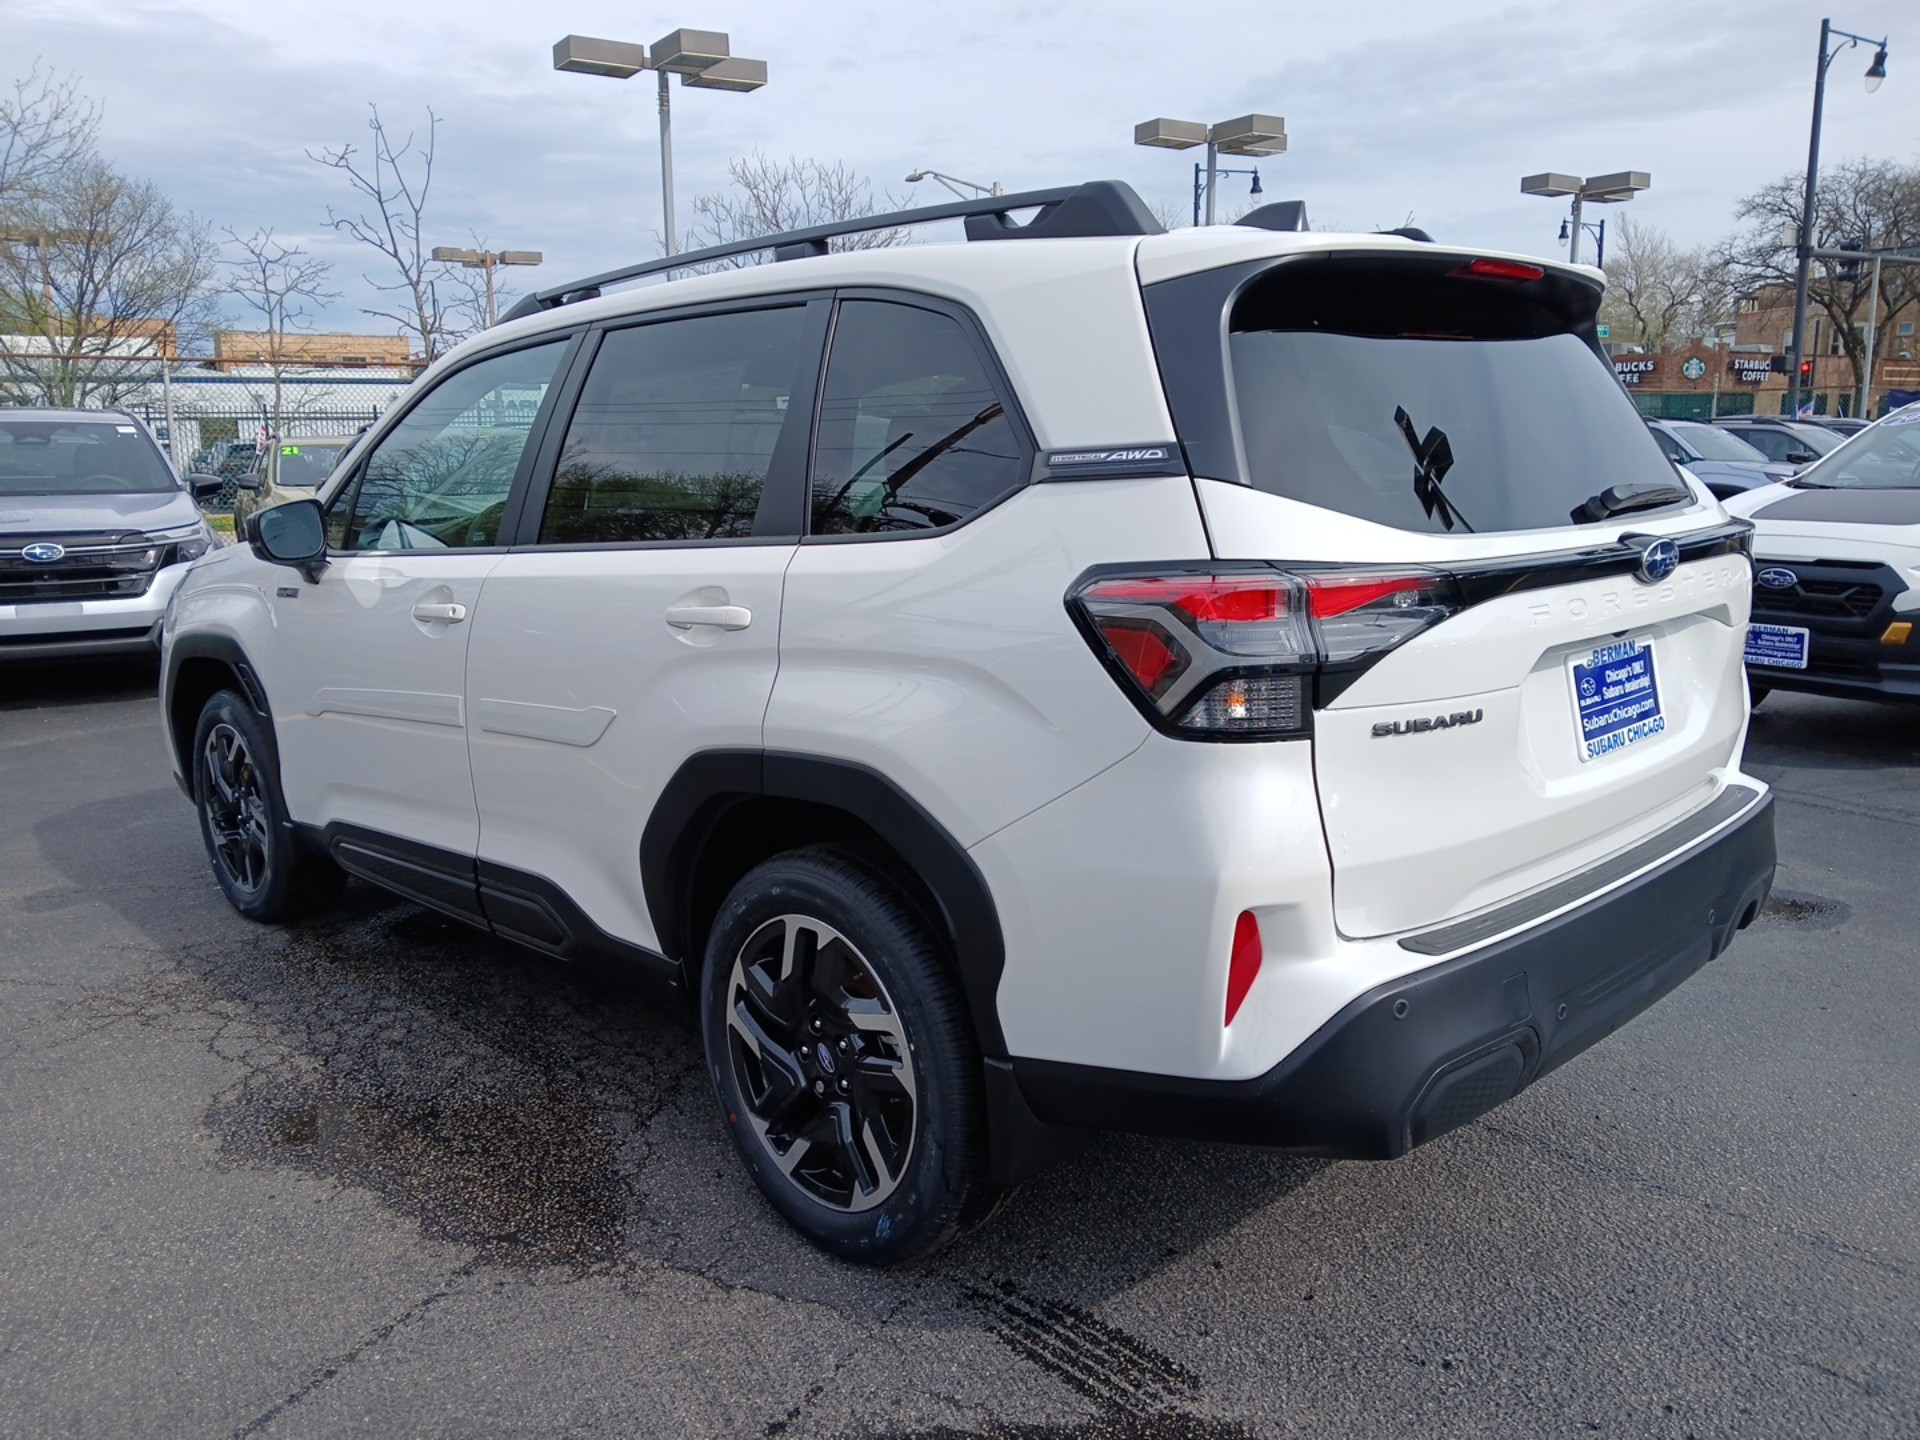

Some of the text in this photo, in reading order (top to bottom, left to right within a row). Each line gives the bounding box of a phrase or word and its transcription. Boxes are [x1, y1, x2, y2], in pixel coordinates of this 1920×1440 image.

[1615, 360, 1654, 372] BUCKS
[1734, 359, 1770, 370] STARBUC
[1742, 371, 1769, 381] COFFEE
[281, 446, 300, 456] 21
[1107, 449, 1163, 461] AWD
[1528, 567, 1737, 627] FORESTER
[1593, 640, 1636, 666] BERMAN
[1745, 647, 1801, 658] baruChicago.com
[1745, 656, 1764, 664] BARU
[1603, 685, 1624, 699] Subaru
[1584, 698, 1656, 732] SubaruChicago.com
[1371, 708, 1483, 738] SUBARU
[1587, 716, 1665, 759] SUBARU CHICAGO
